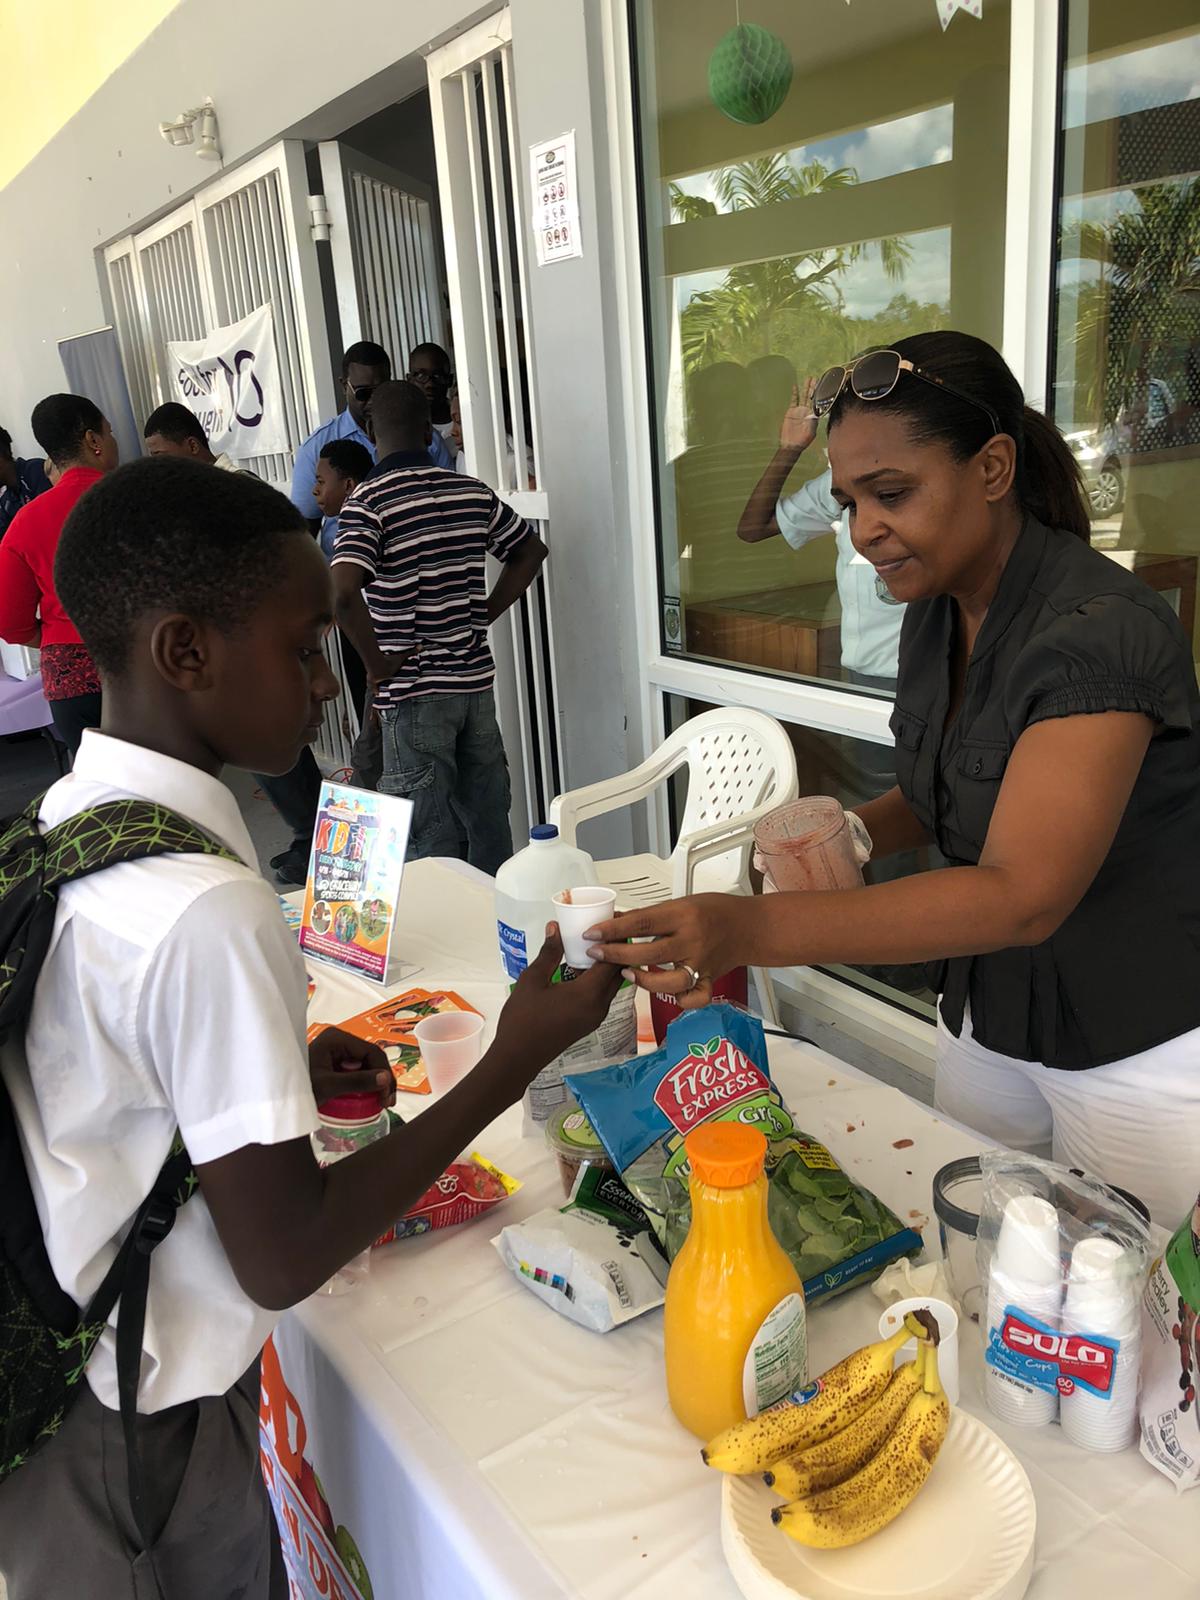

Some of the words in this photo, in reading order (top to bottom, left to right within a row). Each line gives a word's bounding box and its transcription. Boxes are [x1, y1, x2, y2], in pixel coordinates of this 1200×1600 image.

[668, 1042, 749, 1105] Fresh
[681, 1071, 759, 1121] EXPRESS
[1008, 1325, 1106, 1365] SOLO
